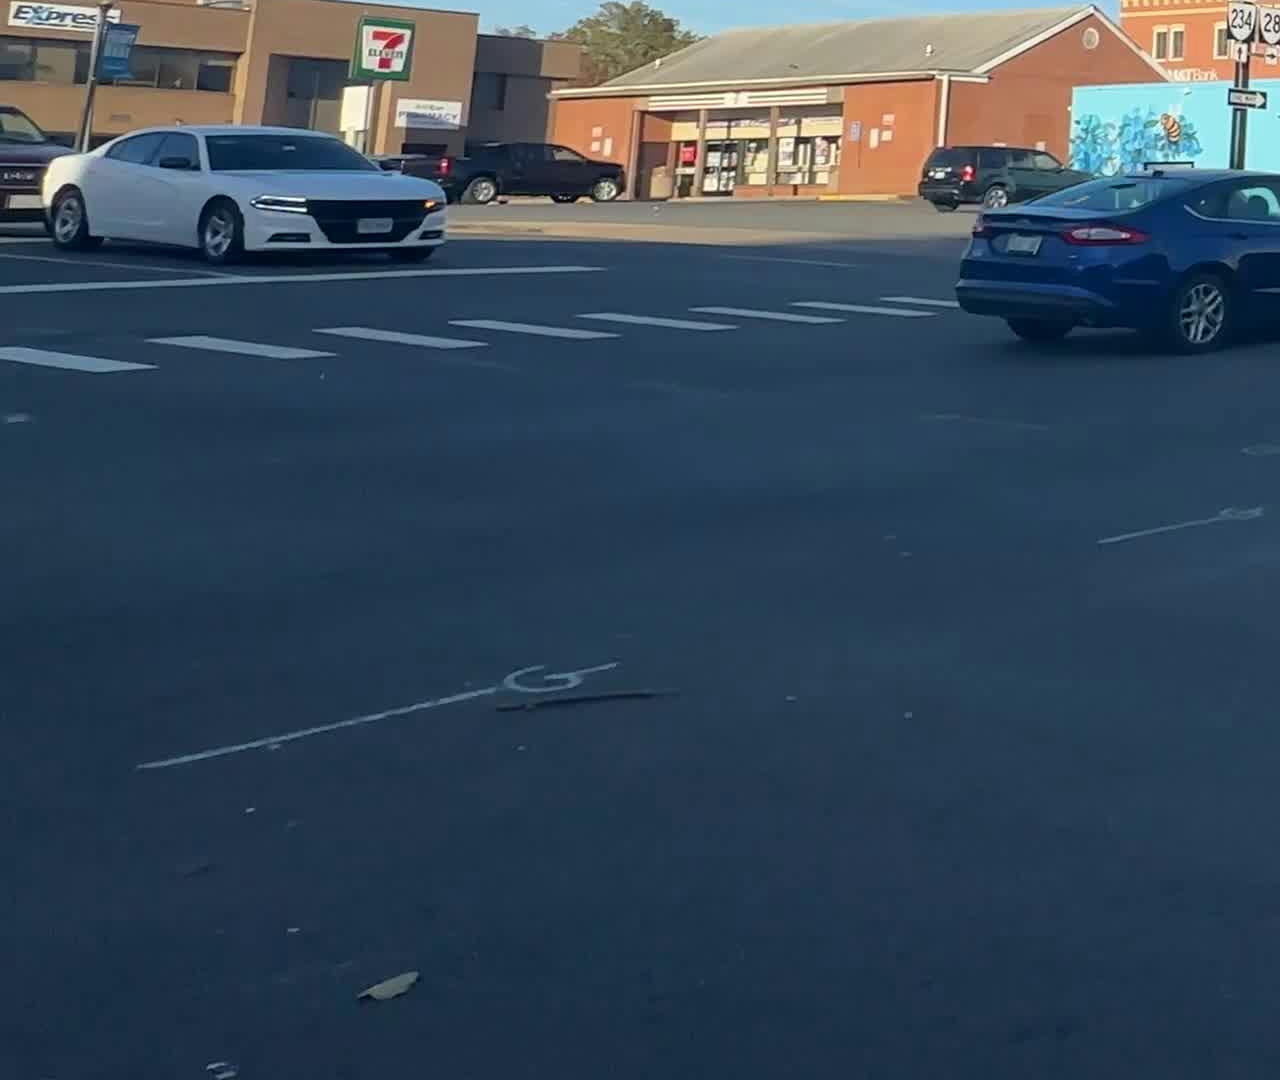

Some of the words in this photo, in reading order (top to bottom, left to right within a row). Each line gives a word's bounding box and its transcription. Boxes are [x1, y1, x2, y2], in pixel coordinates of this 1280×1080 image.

[1231, 8, 1252, 30] 234
[1264, 13, 1280, 33] 28
[371, 31, 405, 69] 7
